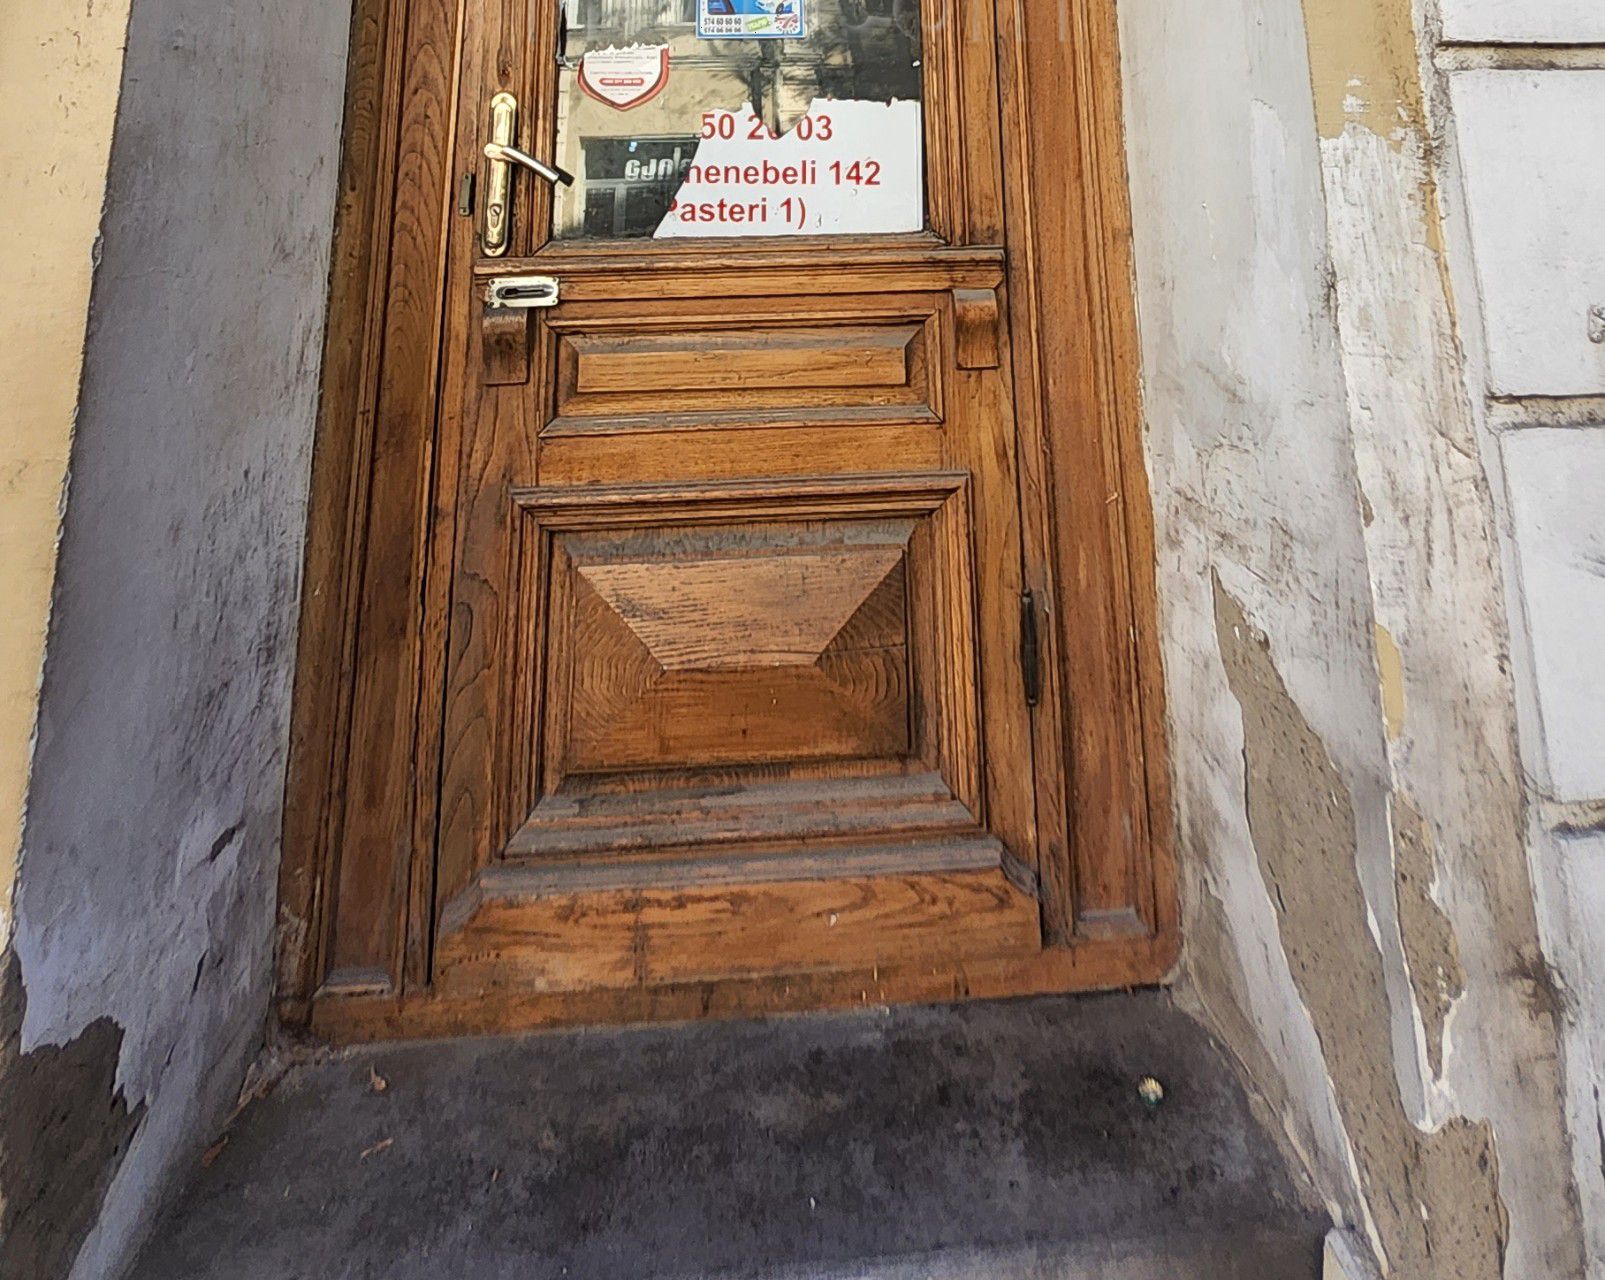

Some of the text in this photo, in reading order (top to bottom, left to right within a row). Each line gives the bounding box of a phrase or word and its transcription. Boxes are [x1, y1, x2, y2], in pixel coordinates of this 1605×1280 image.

[747, 113, 780, 141] 2
[796, 114, 833, 141] 03
[828, 160, 881, 186] 142
[780, 197, 806, 229] 1)
